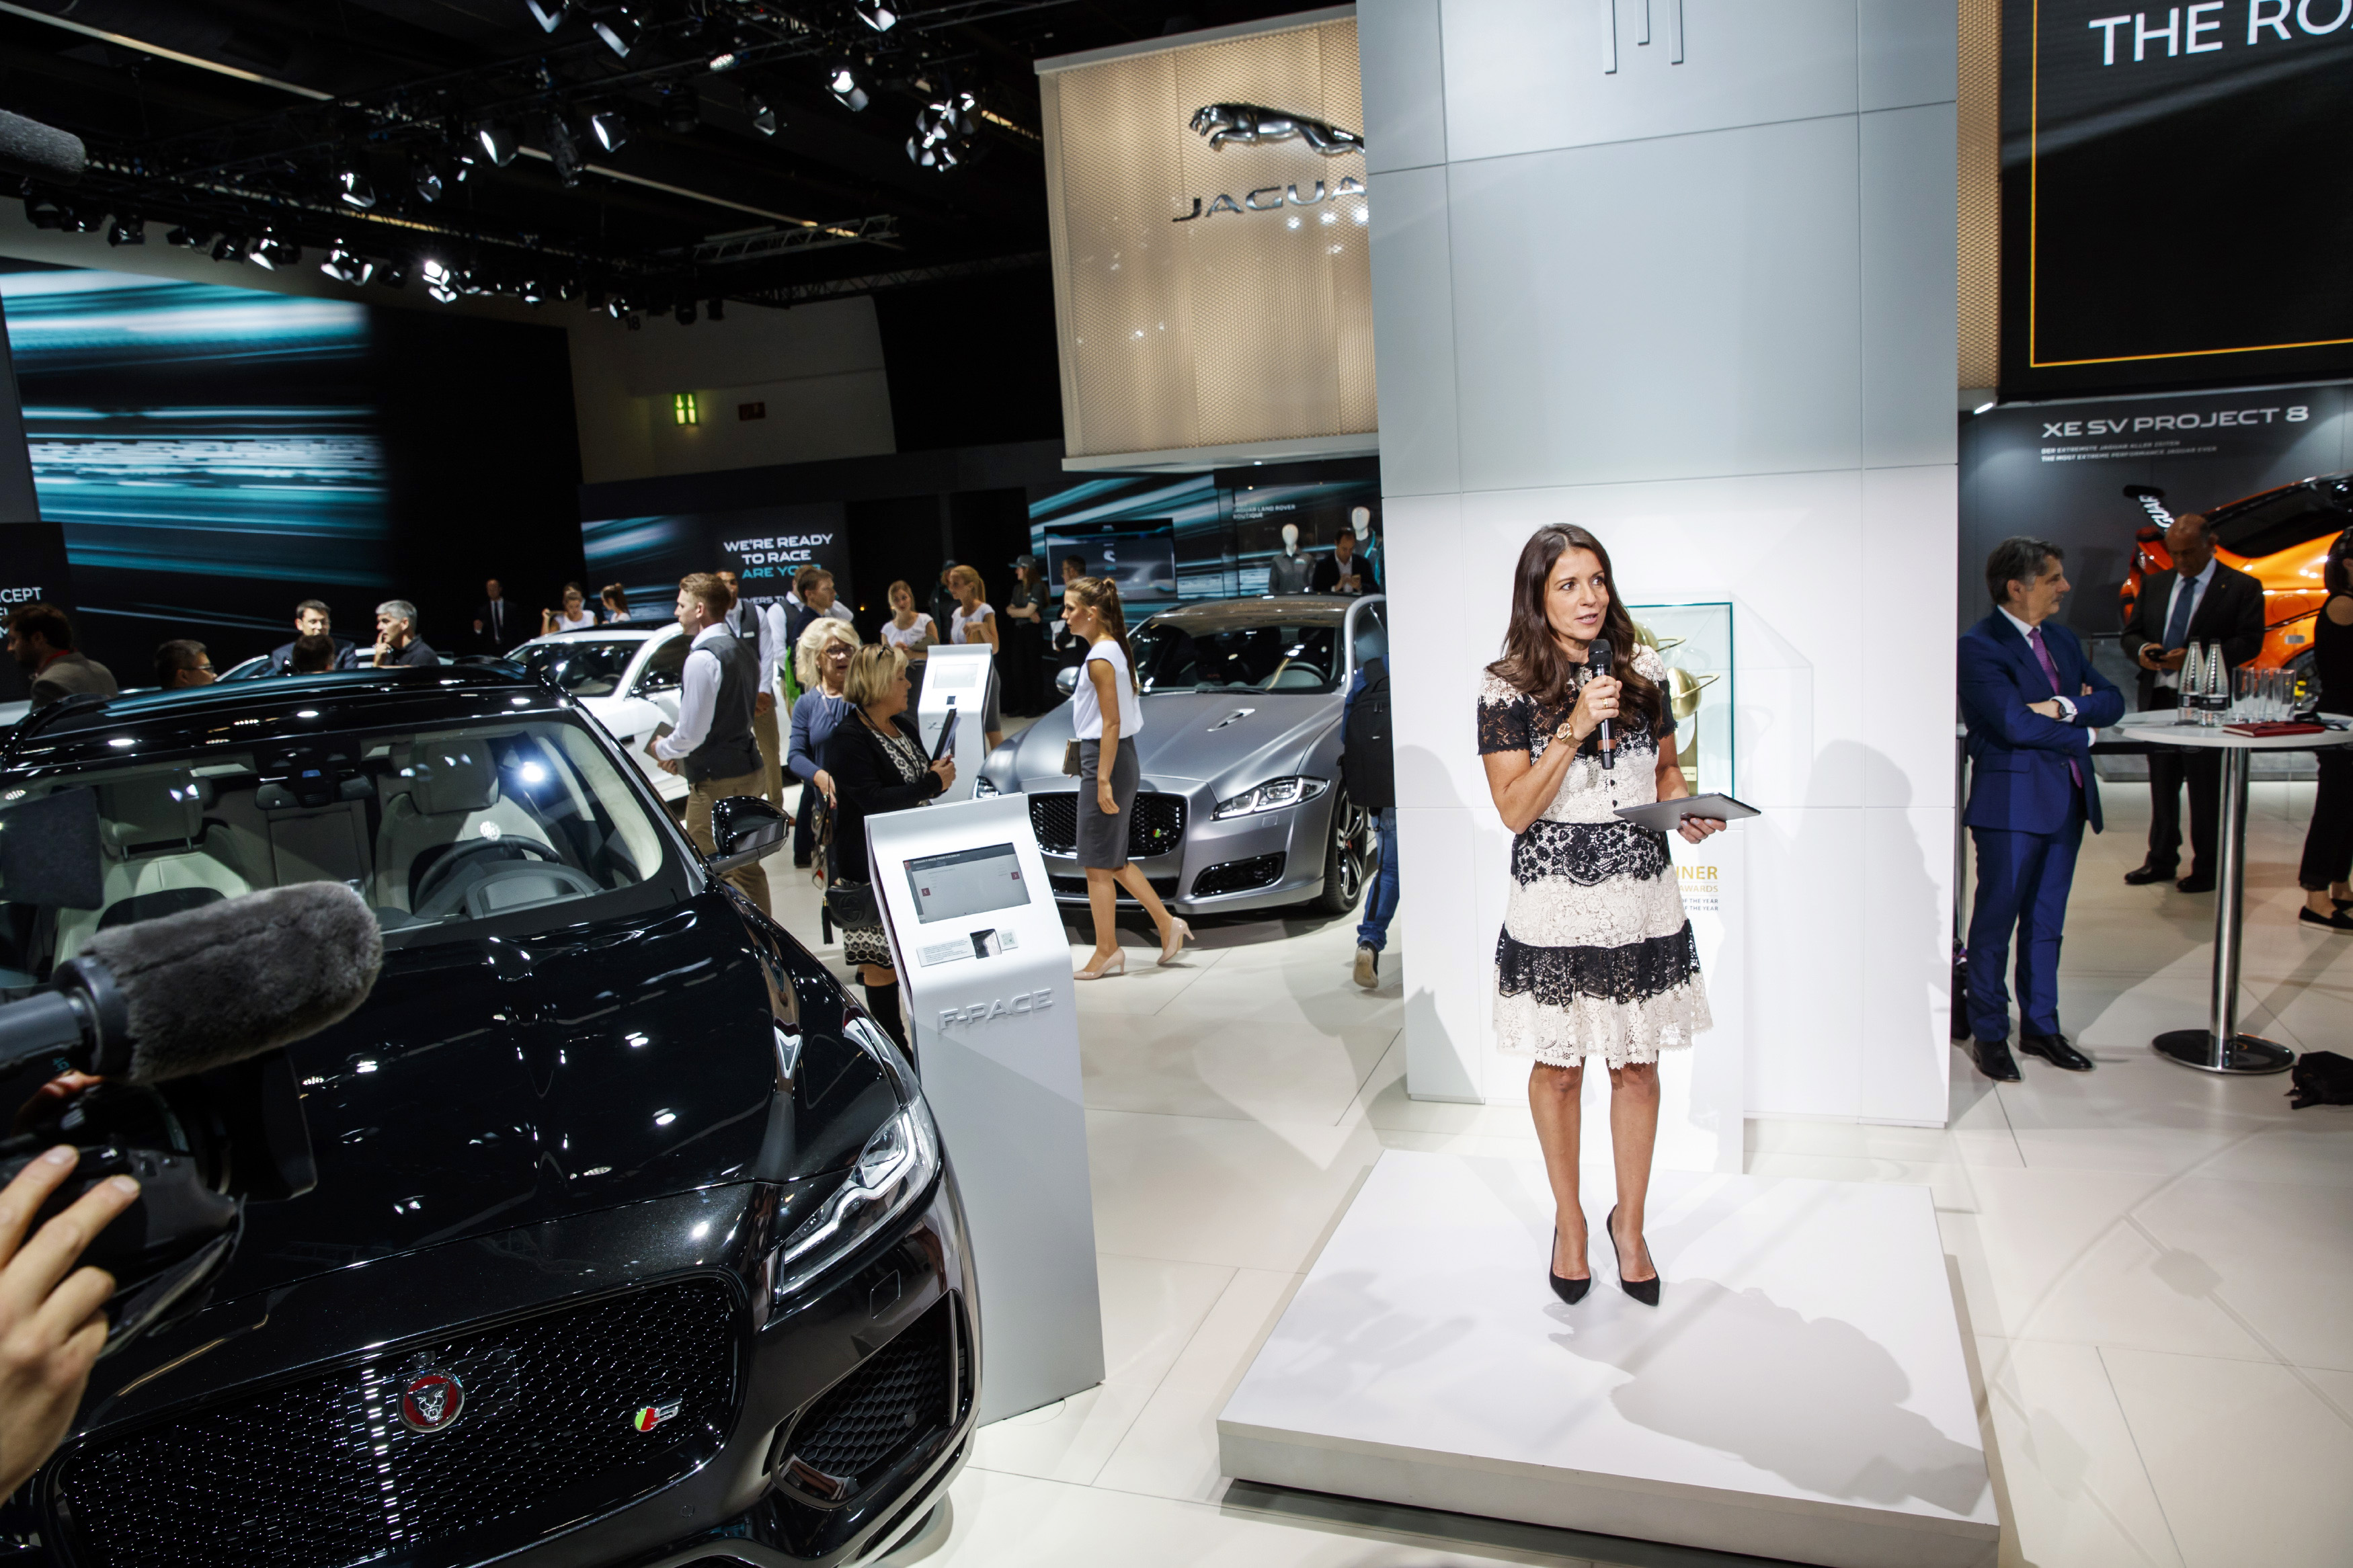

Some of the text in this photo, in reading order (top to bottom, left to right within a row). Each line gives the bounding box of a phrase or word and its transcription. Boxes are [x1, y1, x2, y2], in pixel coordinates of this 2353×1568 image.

[2088, 0, 2353, 65] THE RO
[1172, 176, 1367, 222] JAGUA
[2042, 405, 2309, 438] XE SV PROJECT 8
[723, 533, 833, 552] WE'RE READY
[742, 549, 811, 565] TO RACE
[742, 564, 822, 579] ARE YO
[0, 587, 42, 603] CEPT
[1676, 866, 1718, 880] NER
[939, 988, 1053, 1032] F-PACE
